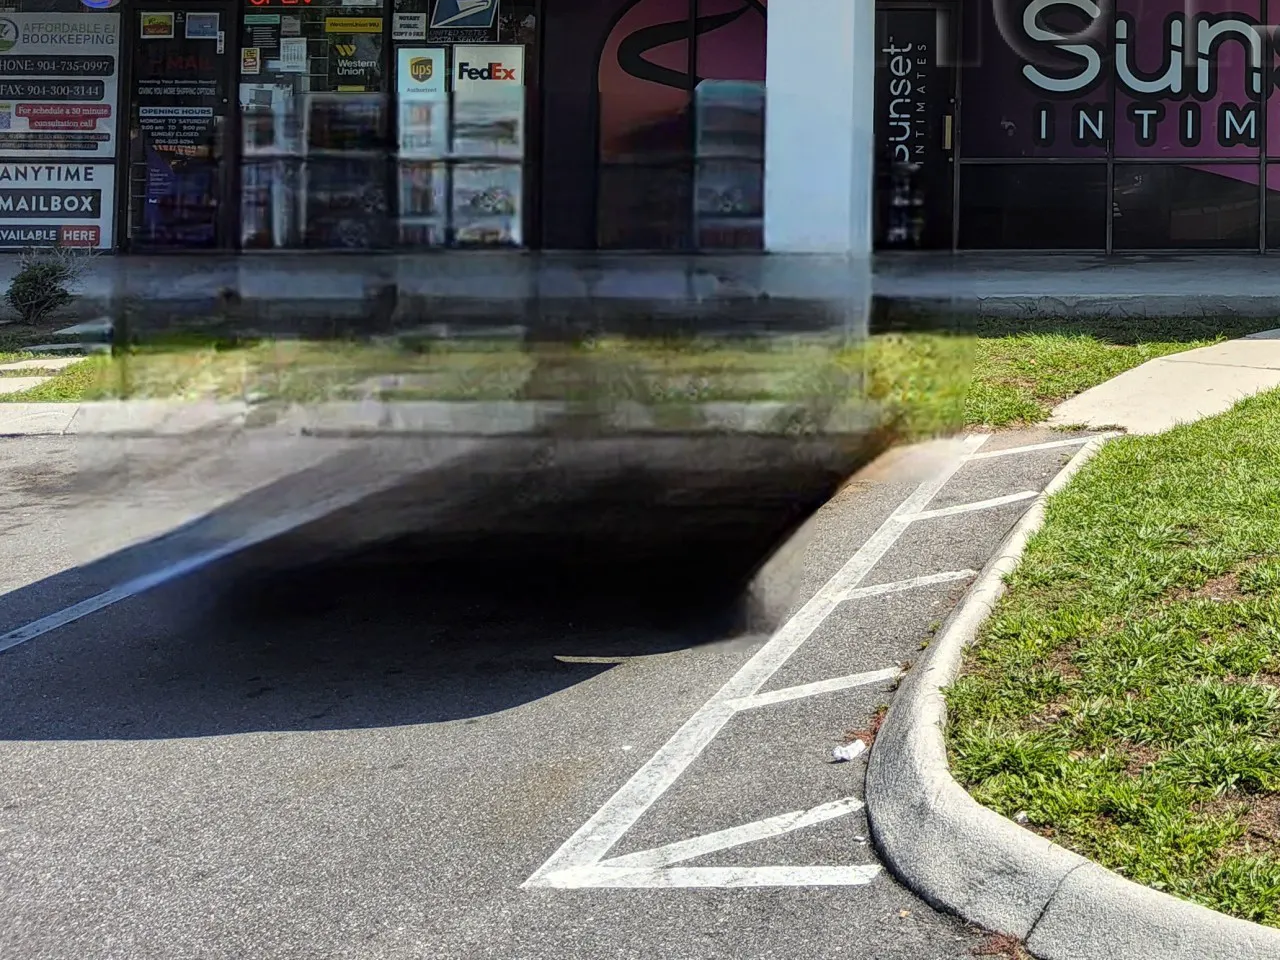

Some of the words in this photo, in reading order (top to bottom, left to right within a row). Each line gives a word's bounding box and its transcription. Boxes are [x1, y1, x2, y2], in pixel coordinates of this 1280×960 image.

[22, 23, 102, 33] AFFORDABLE
[22, 34, 115, 44] BOOKKEEPING
[0, 60, 34, 71] HONE:
[37, 61, 110, 71] 904-735-0997
[337, 59, 376, 68] Western
[337, 68, 365, 76] Union
[458, 62, 516, 80] FedEx
[0, 85, 24, 95] FAX:
[27, 85, 99, 95] 904-300-3144
[33, 106, 64, 115] schedule
[34, 119, 78, 127] consultation
[80, 119, 93, 127] call
[0, 166, 94, 181] ANYTIME
[0, 195, 93, 211] MAILBOX
[63, 230, 96, 240] HERE
